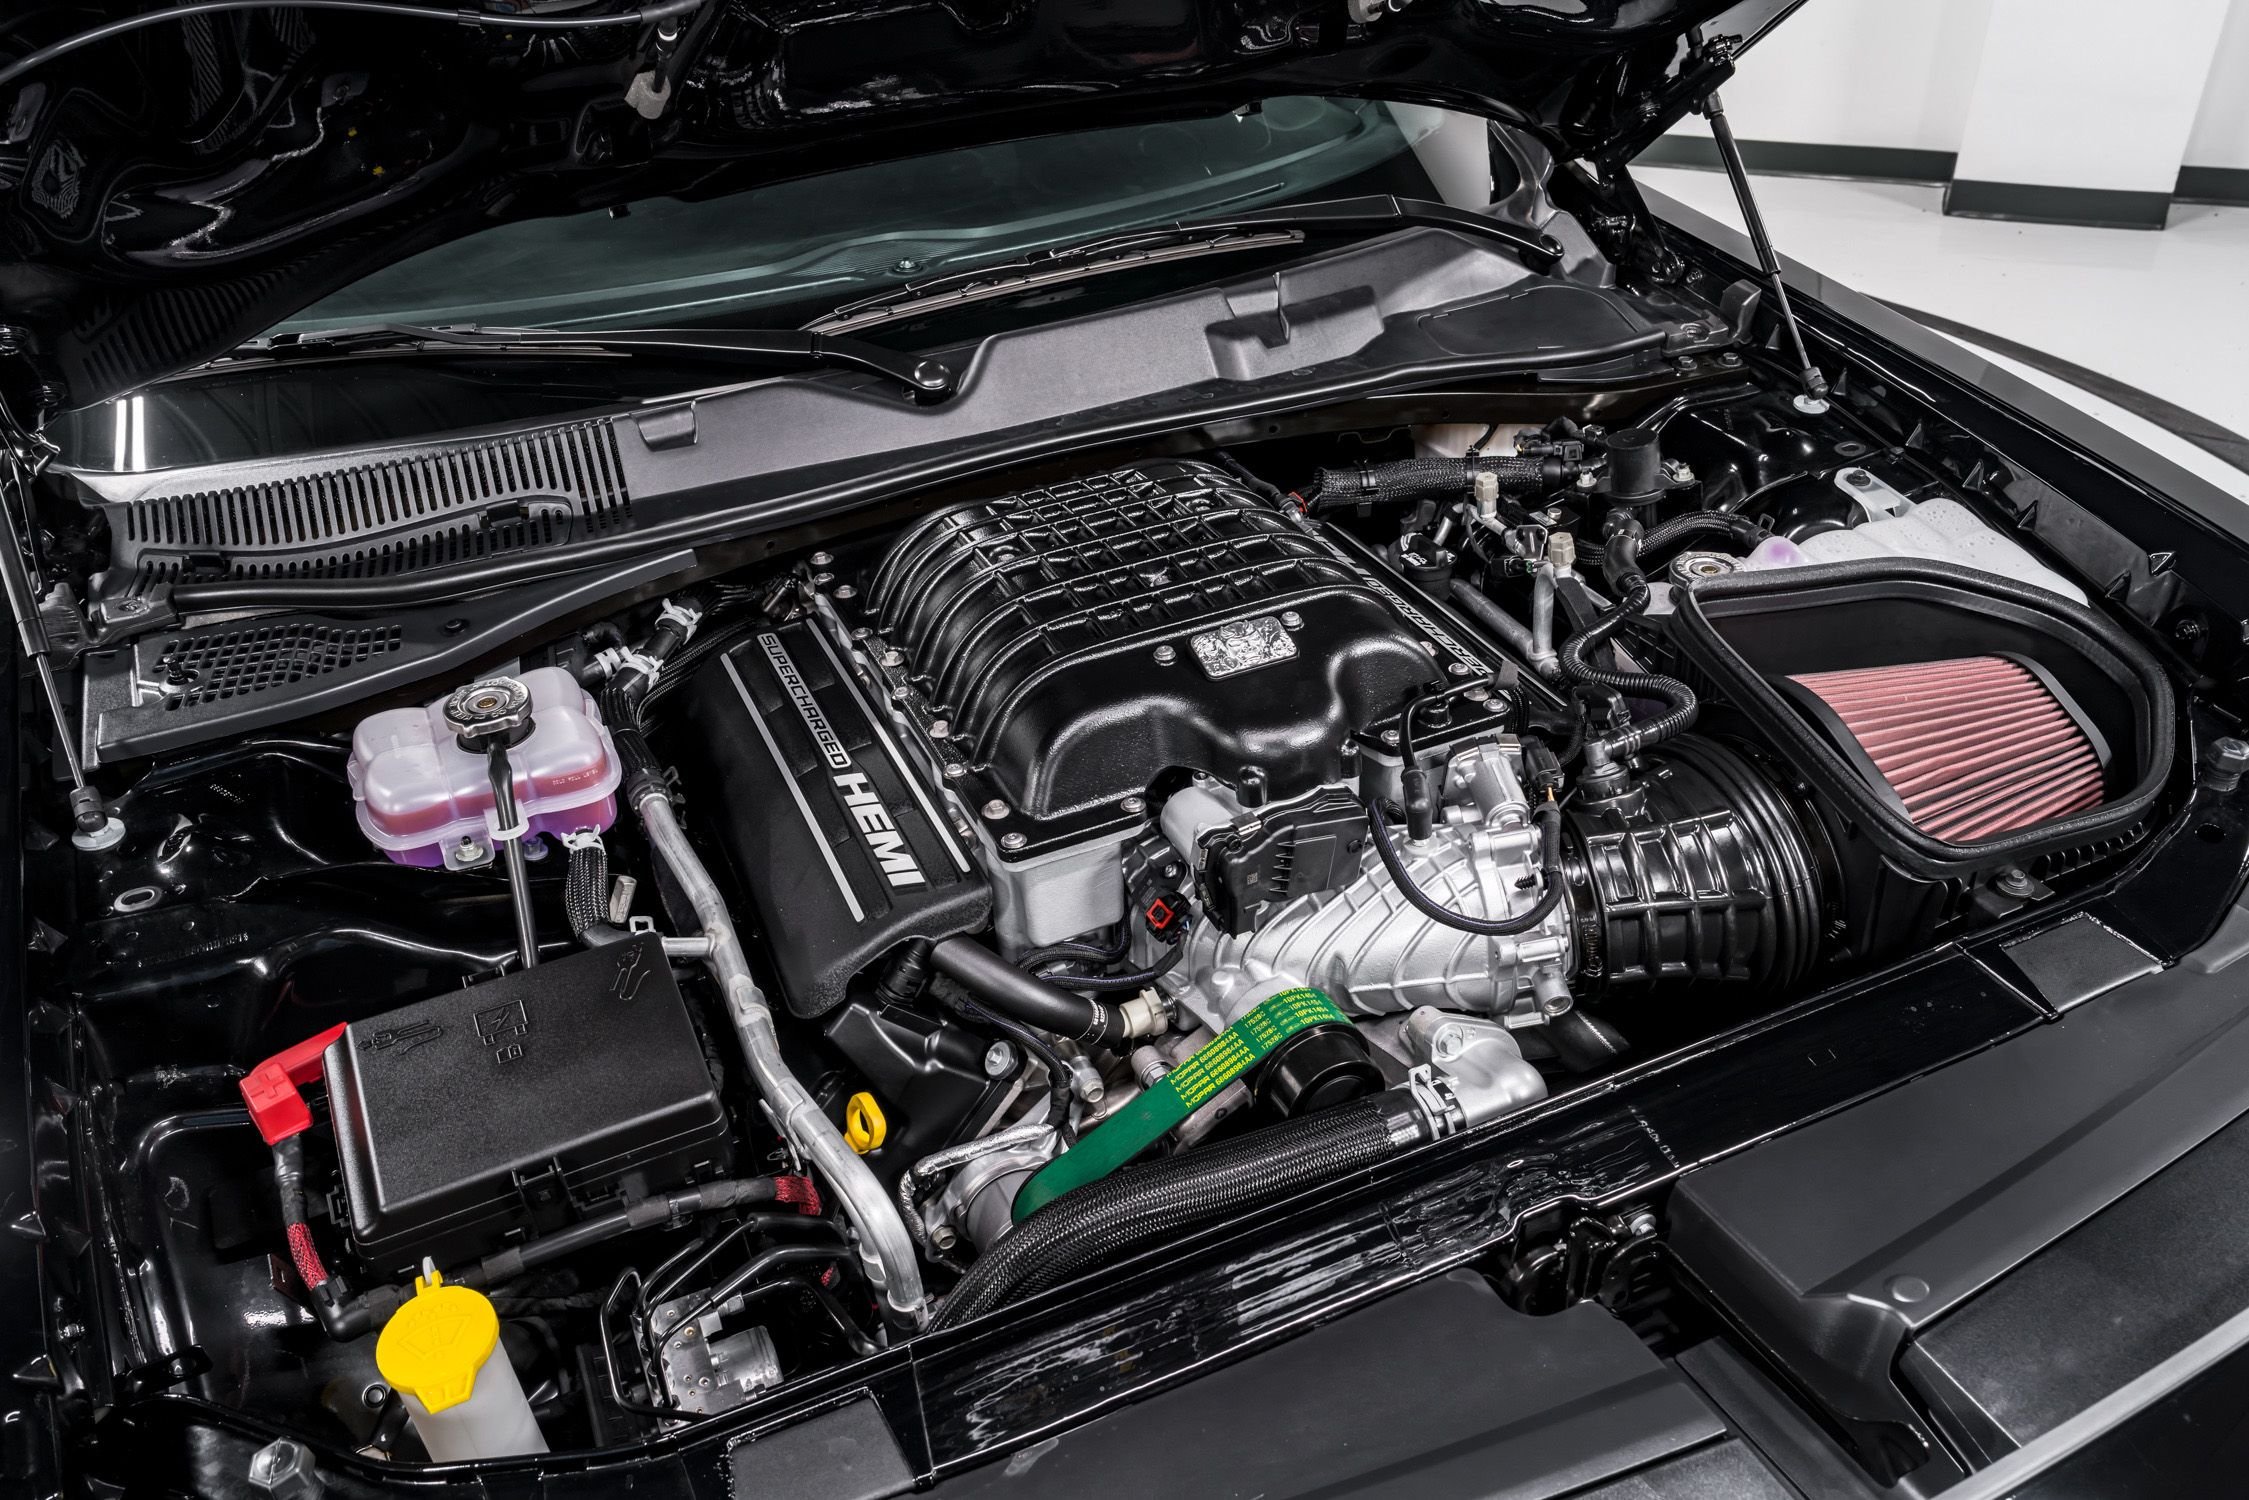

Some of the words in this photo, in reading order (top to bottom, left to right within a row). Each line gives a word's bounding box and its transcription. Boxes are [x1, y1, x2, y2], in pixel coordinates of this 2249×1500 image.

[760, 633, 848, 768] SUPERCHARGED
[832, 772, 926, 887] HEMI
[1170, 1061, 1200, 1085] MOPAR
[1175, 1068, 1205, 1092] MOPAR
[1181, 1075, 1210, 1100] MOPAR
[1185, 1083, 1216, 1108] MOPAR
